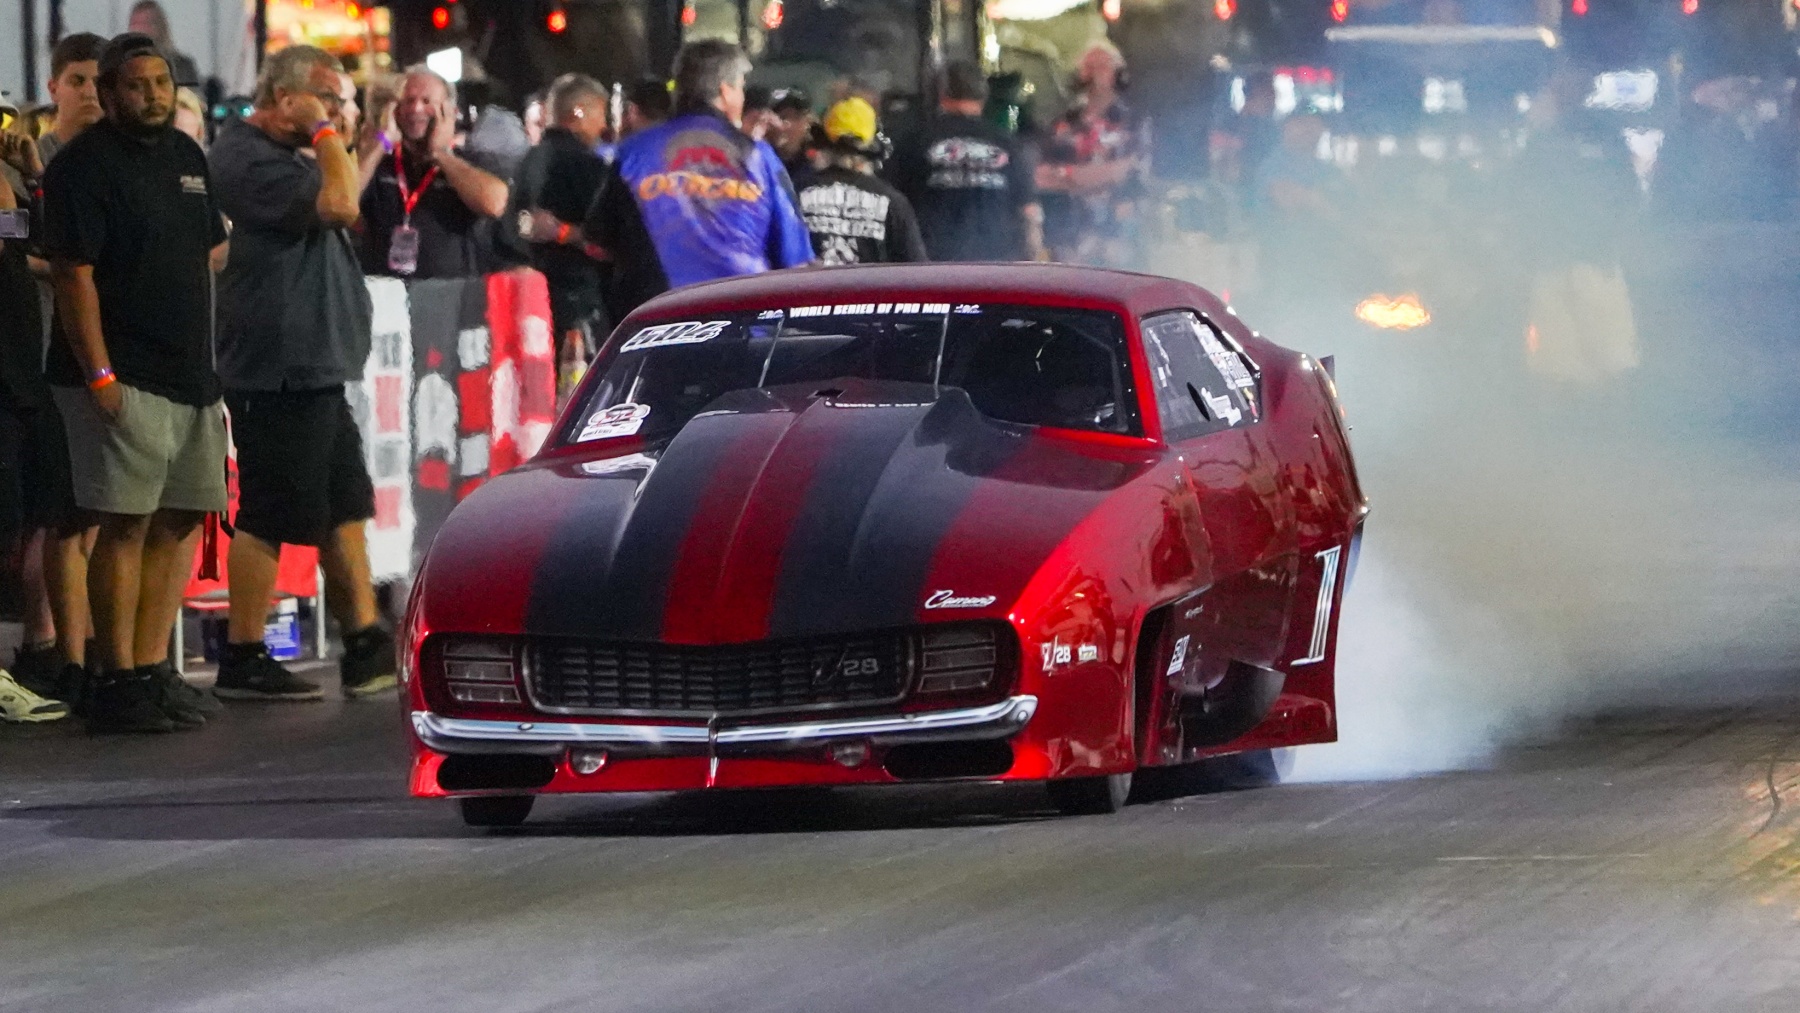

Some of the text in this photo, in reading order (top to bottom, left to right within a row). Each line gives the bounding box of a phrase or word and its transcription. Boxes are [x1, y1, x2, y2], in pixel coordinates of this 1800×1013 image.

[789, 305, 832, 318] WORLD
[833, 304, 876, 315] SERIES
[877, 303, 893, 314] OF
[894, 303, 921, 314] PRO
[922, 303, 951, 314] MOD
[925, 589, 996, 609] Camaro
